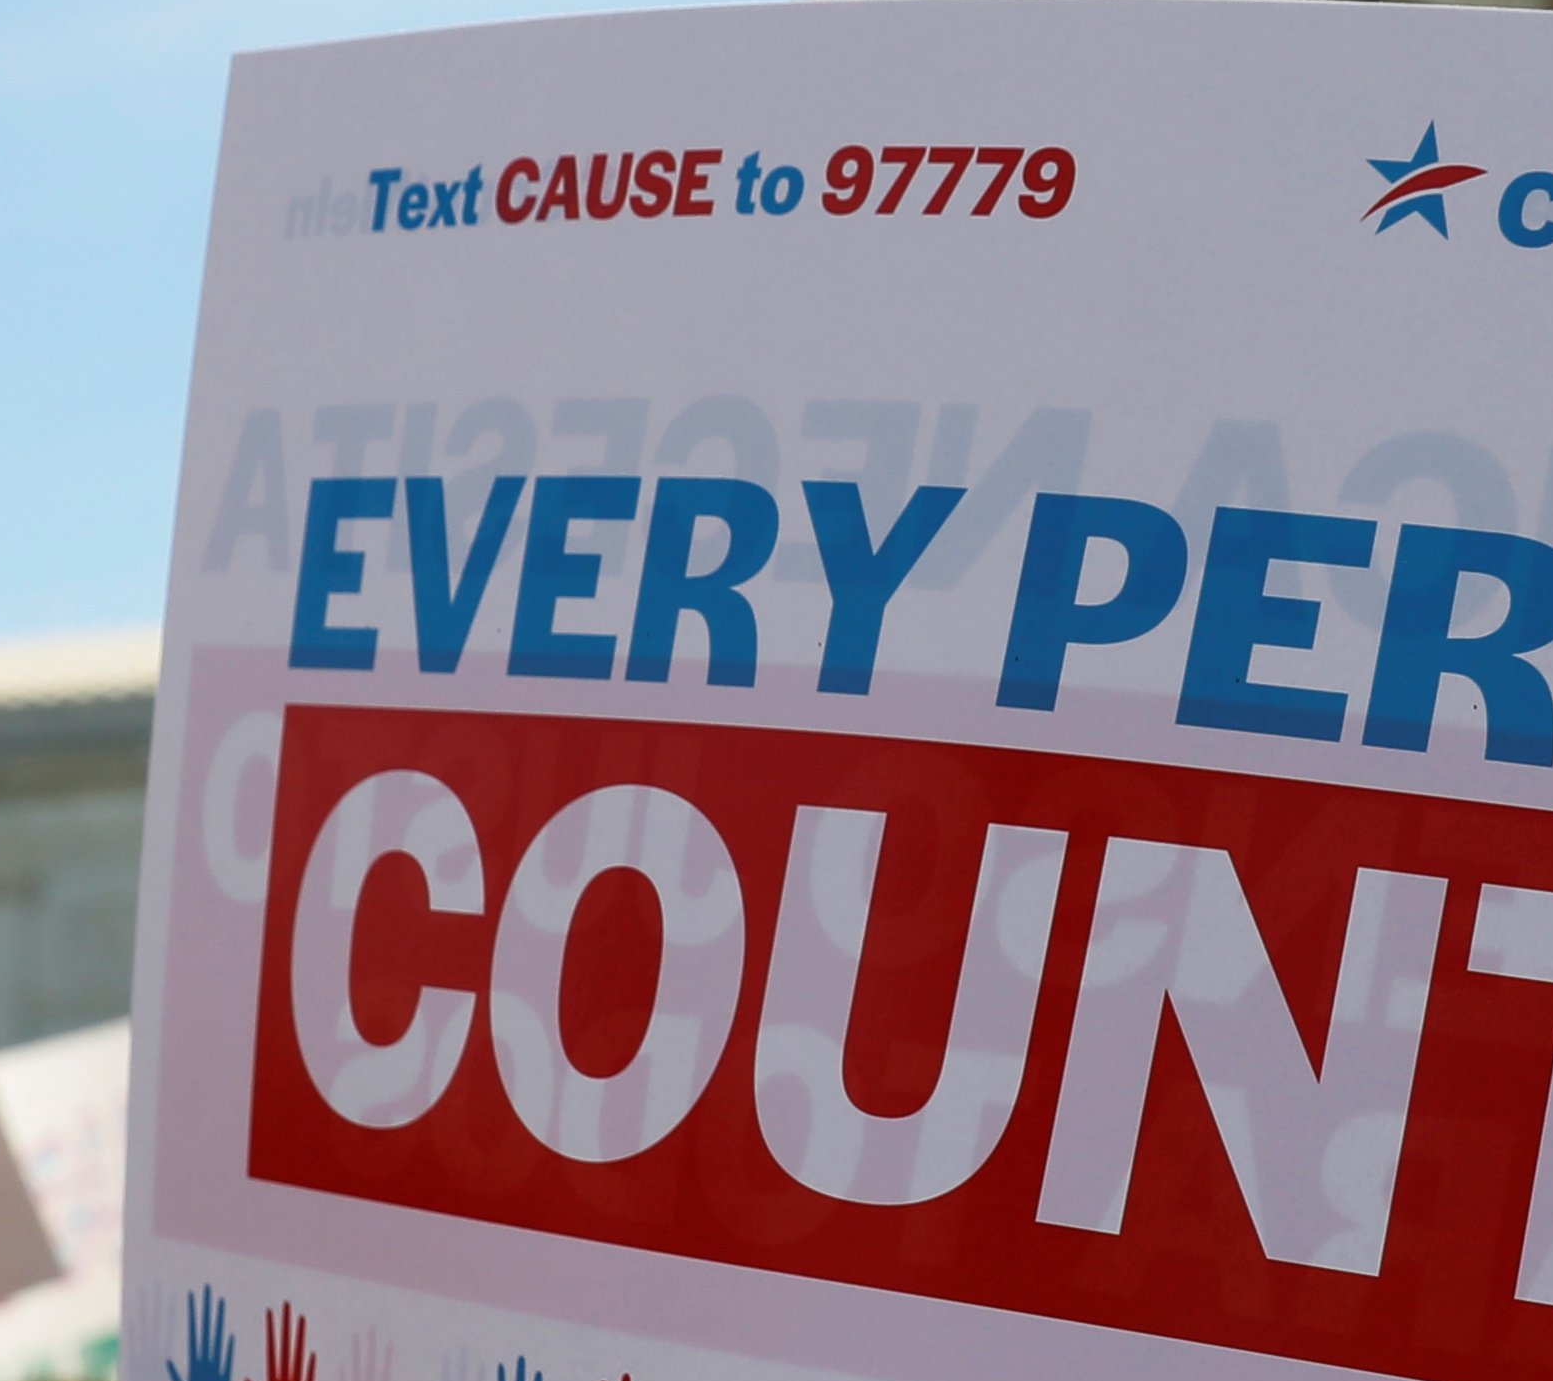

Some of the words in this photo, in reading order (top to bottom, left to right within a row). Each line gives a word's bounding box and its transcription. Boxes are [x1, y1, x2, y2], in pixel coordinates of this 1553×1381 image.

[367, 165, 483, 233] Text
[494, 147, 722, 223] CAUSE
[735, 149, 805, 216] to
[821, 145, 1077, 220] 97779
[287, 474, 969, 696] EVERY
